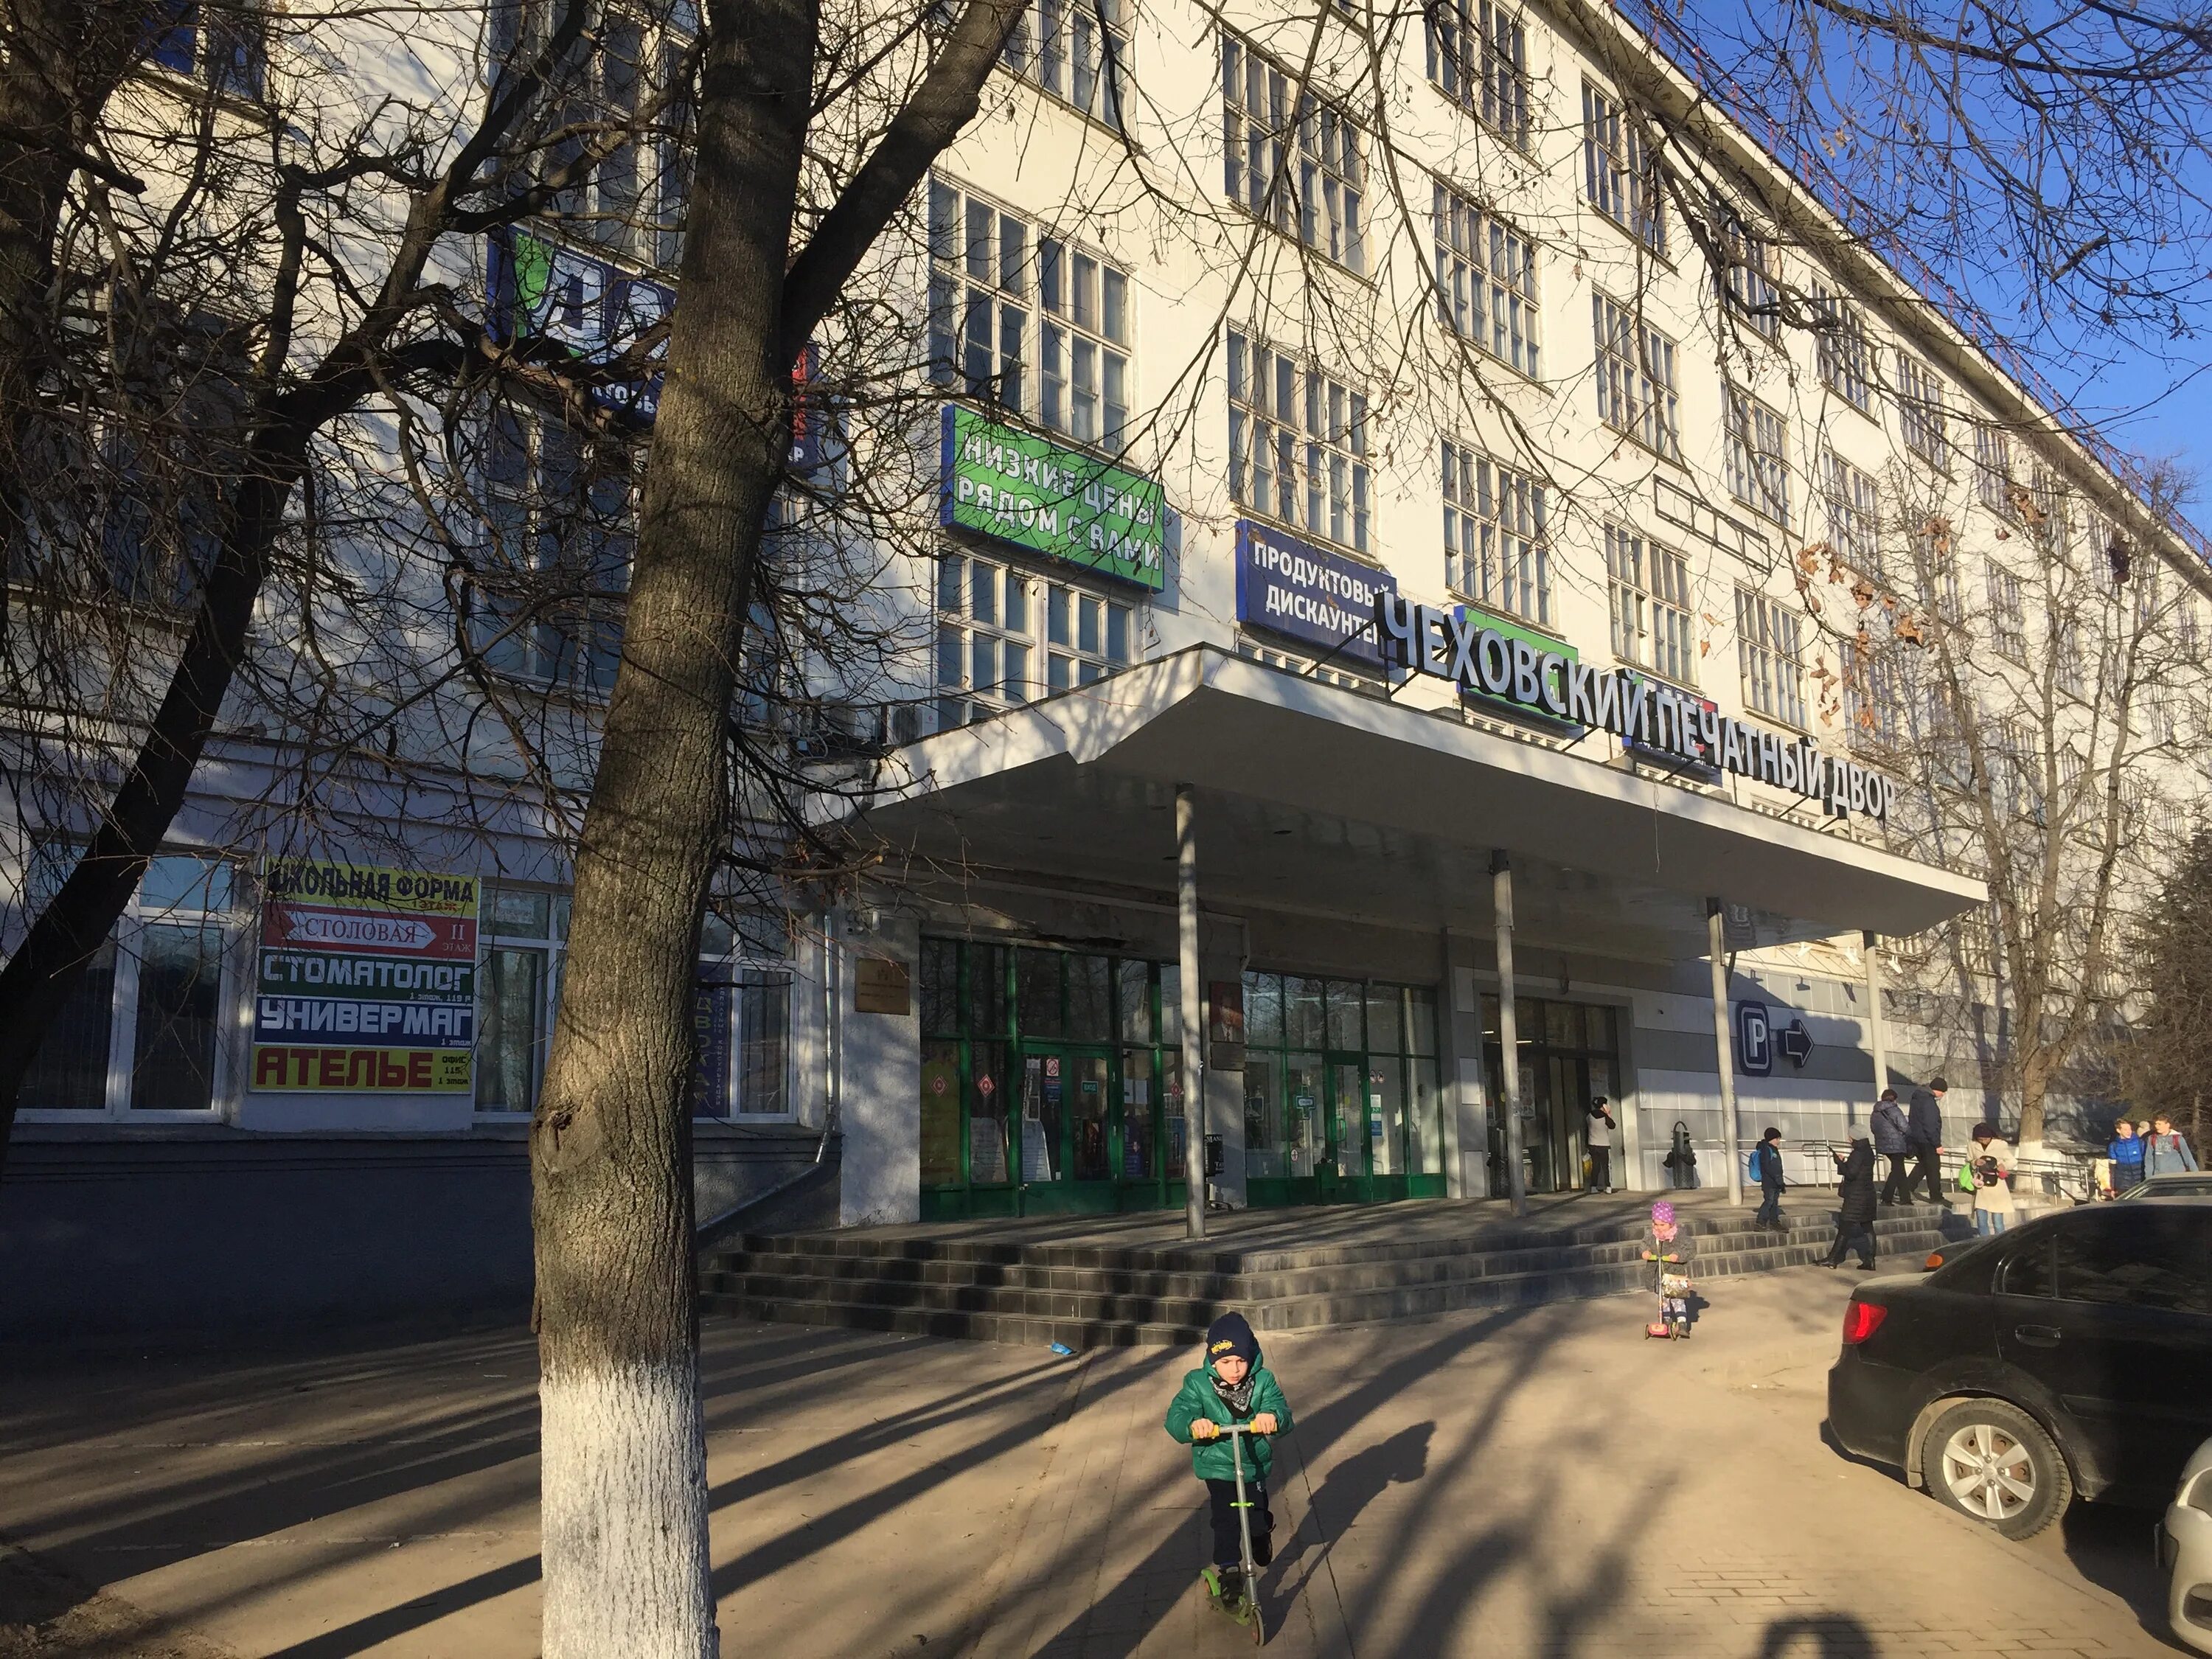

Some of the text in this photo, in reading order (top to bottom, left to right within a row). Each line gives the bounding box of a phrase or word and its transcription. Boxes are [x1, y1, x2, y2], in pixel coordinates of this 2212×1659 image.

[964, 431, 1155, 526] НИЗКИЕ ЦЕНЫ
[959, 476, 1160, 570] РЯДОМ С ВАМИ
[1254, 541, 1389, 608] ПРОДУКТОВЫ
[1377, 591, 1896, 821] ЧЕХОВСКИЙ ПЕЧАТНЫЙ ДВОР
[397, 876, 473, 902] ФОРМА
[305, 918, 415, 943] СТОЛОВАЯ
[443, 943, 471, 953] ЭТАЖ
[263, 954, 471, 992] СТОМАТОЛОГ
[261, 999, 472, 1036] УНИВЕРМАГ
[1747, 1018, 1766, 1057] P
[256, 1048, 433, 1088] АТЕЛЬЕ
